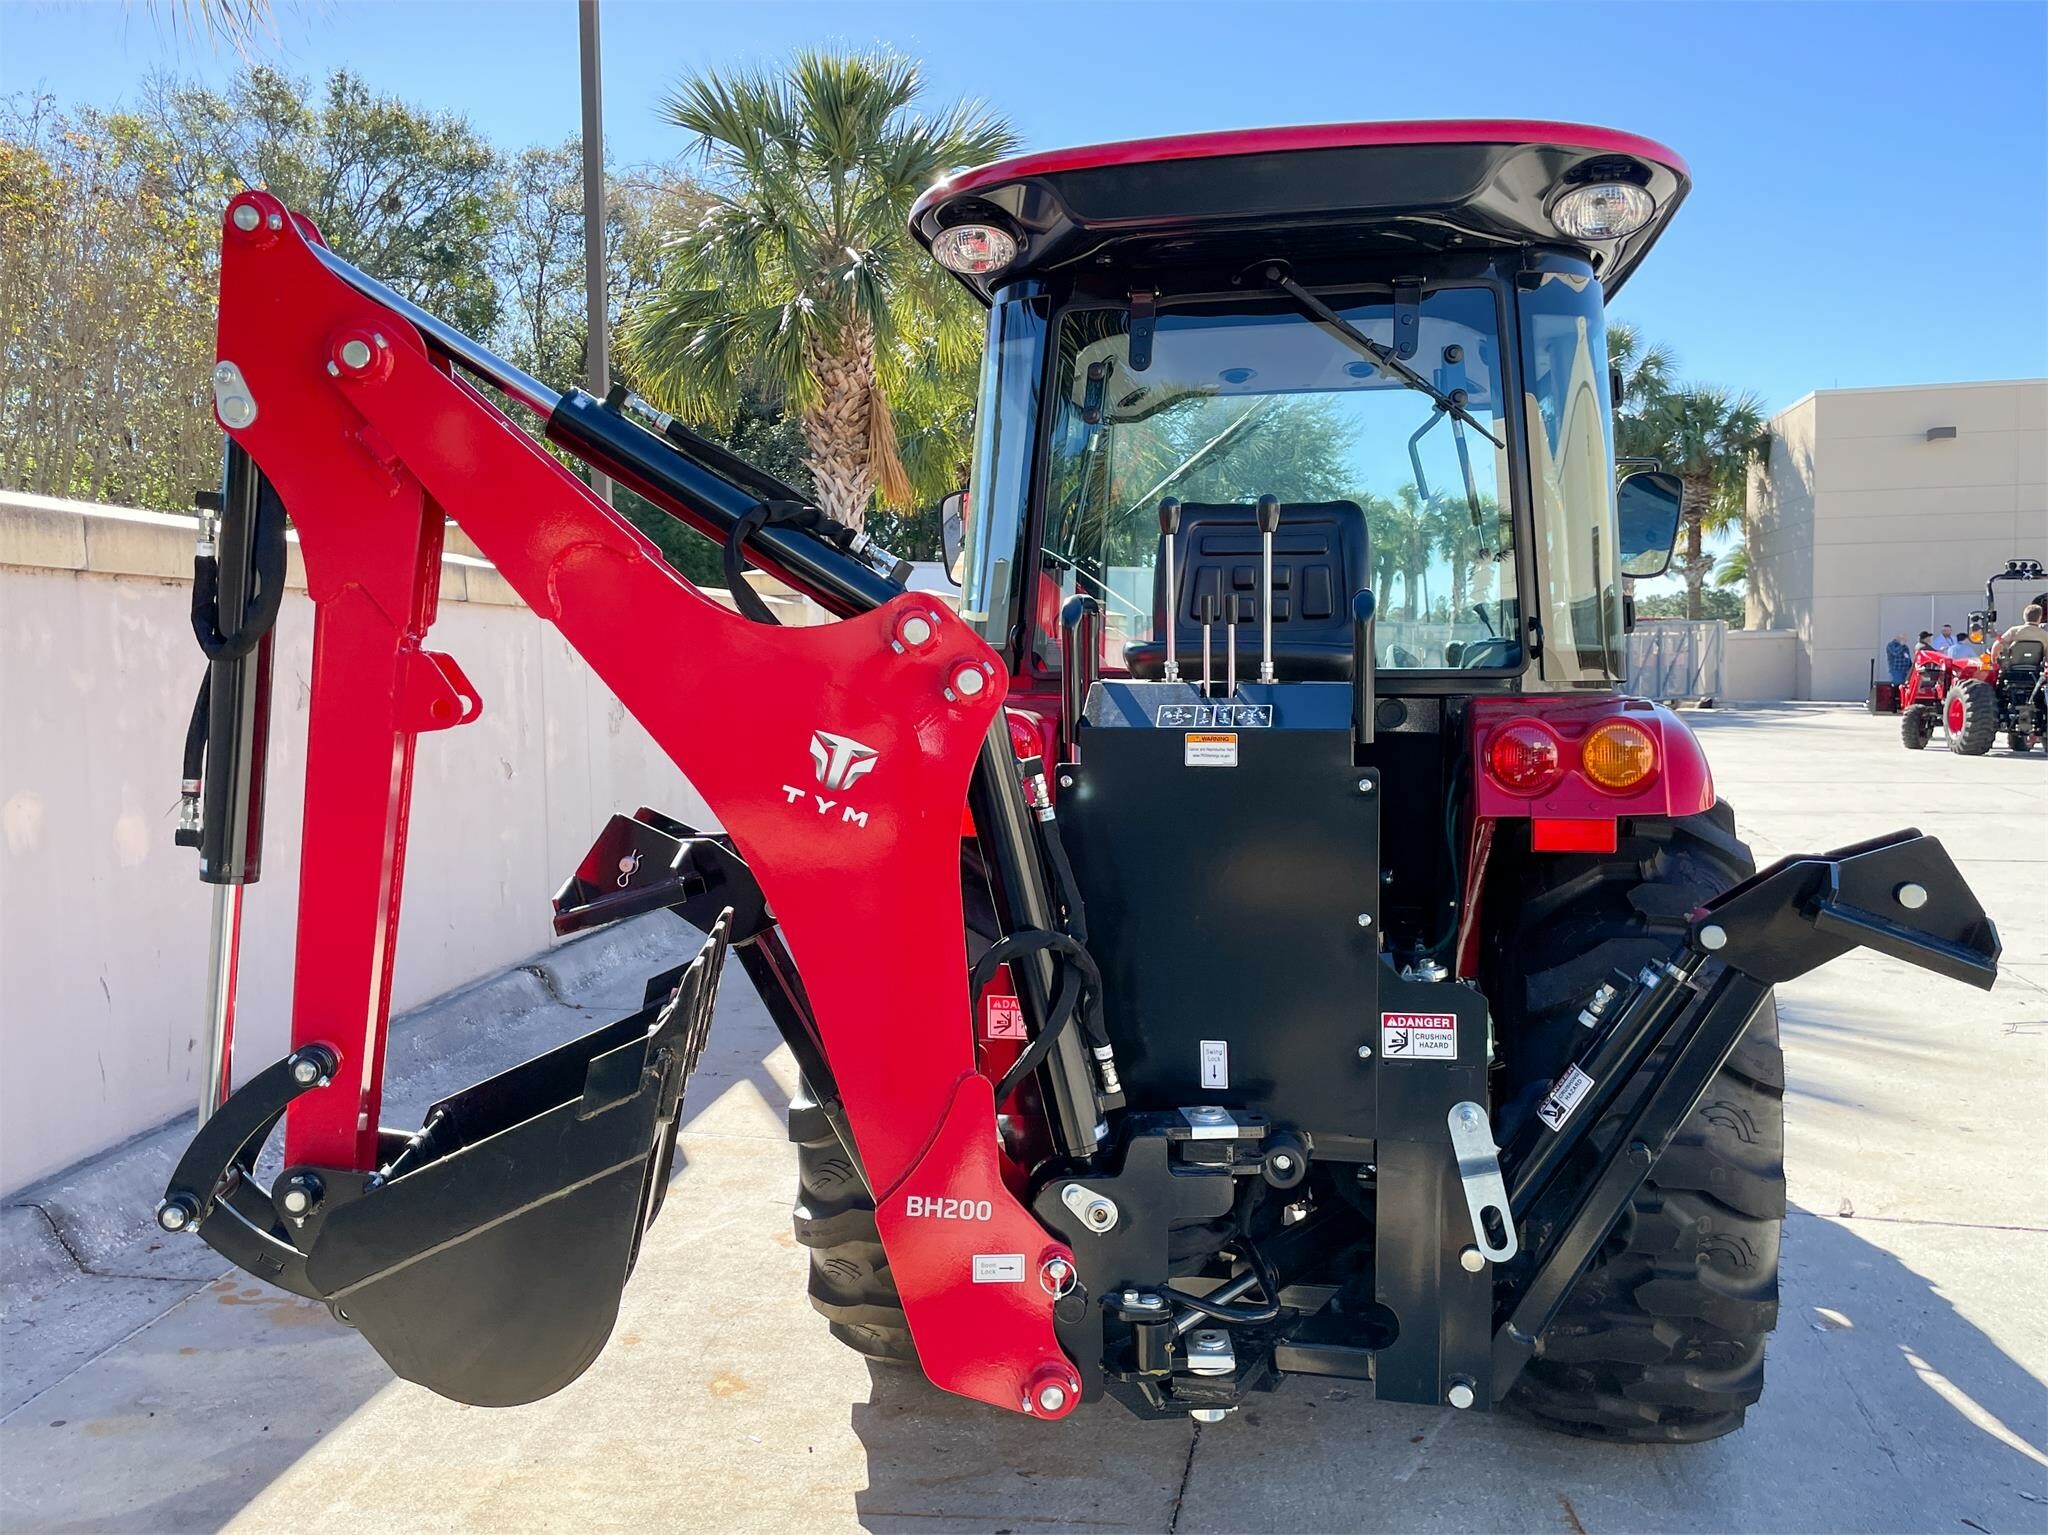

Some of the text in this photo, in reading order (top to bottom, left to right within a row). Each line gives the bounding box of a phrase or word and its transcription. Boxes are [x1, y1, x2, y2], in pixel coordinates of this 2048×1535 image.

[782, 784, 869, 828] TYM
[1397, 1017, 1450, 1027] DANGER
[1414, 1033, 1453, 1041] CRUSHING
[1558, 1071, 1580, 1099] CRUSHING
[1564, 1078, 1583, 1101] HAZARD
[906, 1195, 993, 1221] BH200
